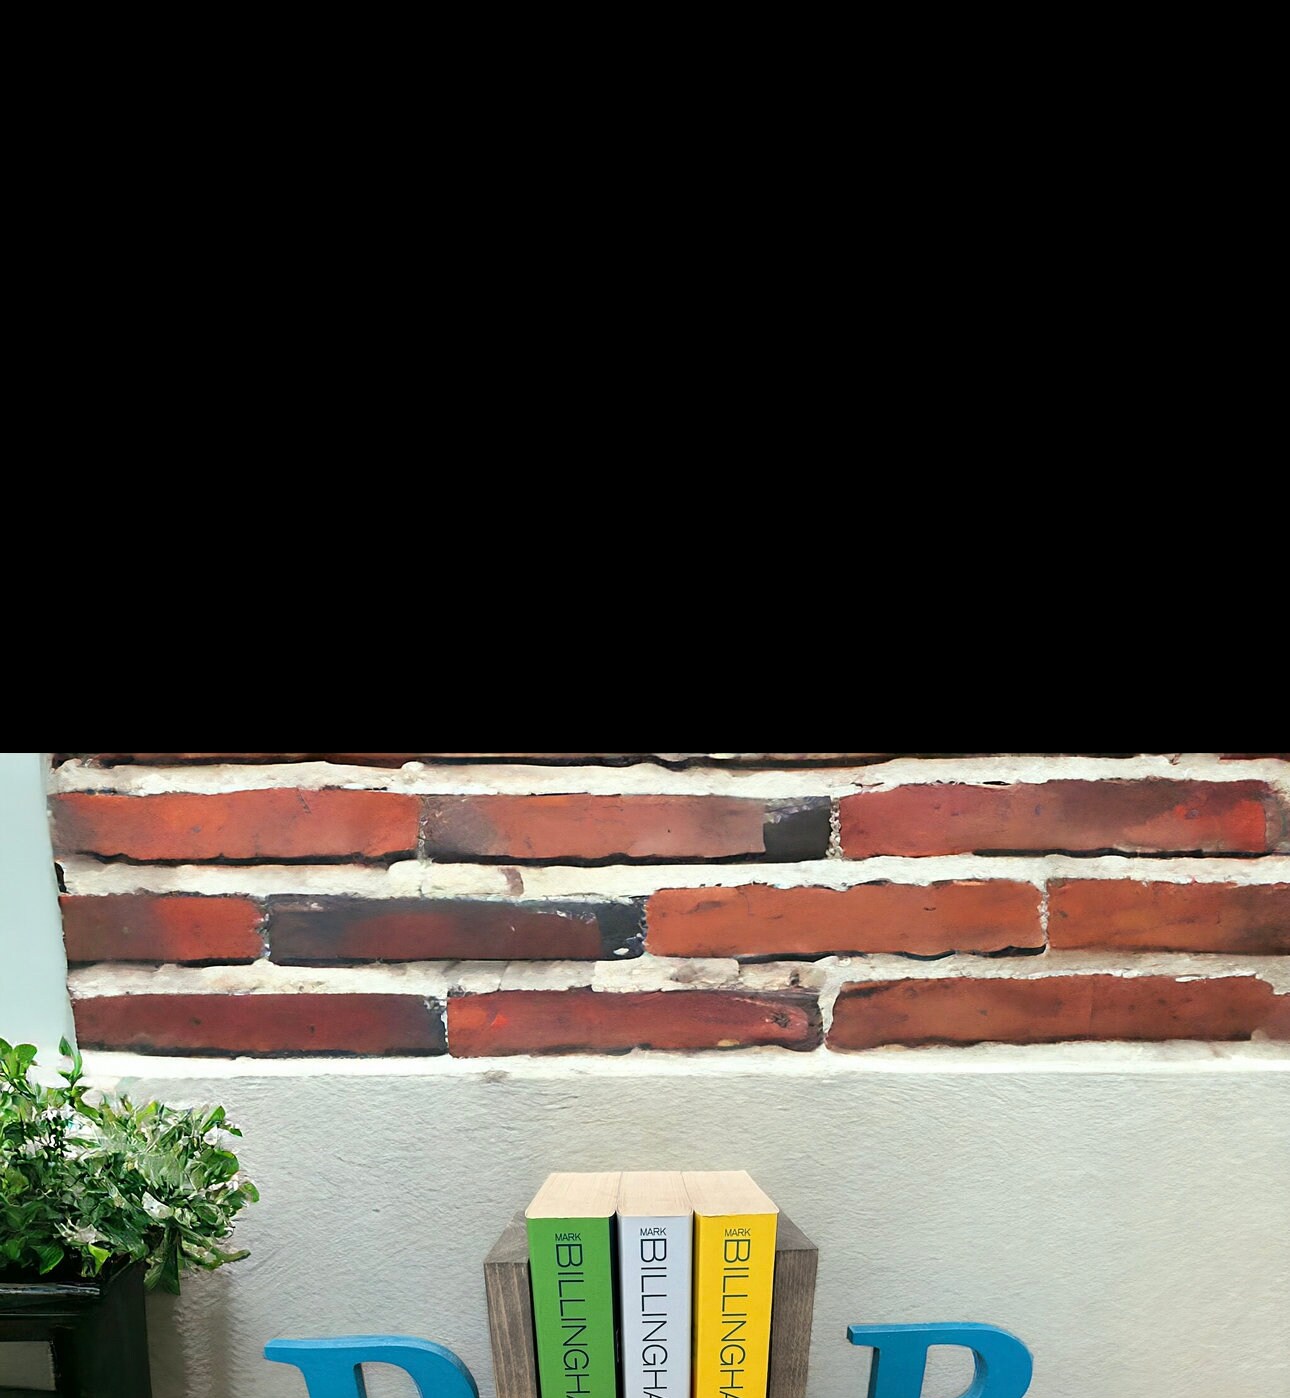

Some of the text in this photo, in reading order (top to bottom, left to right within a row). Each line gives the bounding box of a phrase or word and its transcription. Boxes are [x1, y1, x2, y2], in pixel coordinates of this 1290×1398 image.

[640, 1228, 667, 1236] MARK
[724, 1228, 751, 1237] MARK
[555, 1233, 581, 1242] MARK
